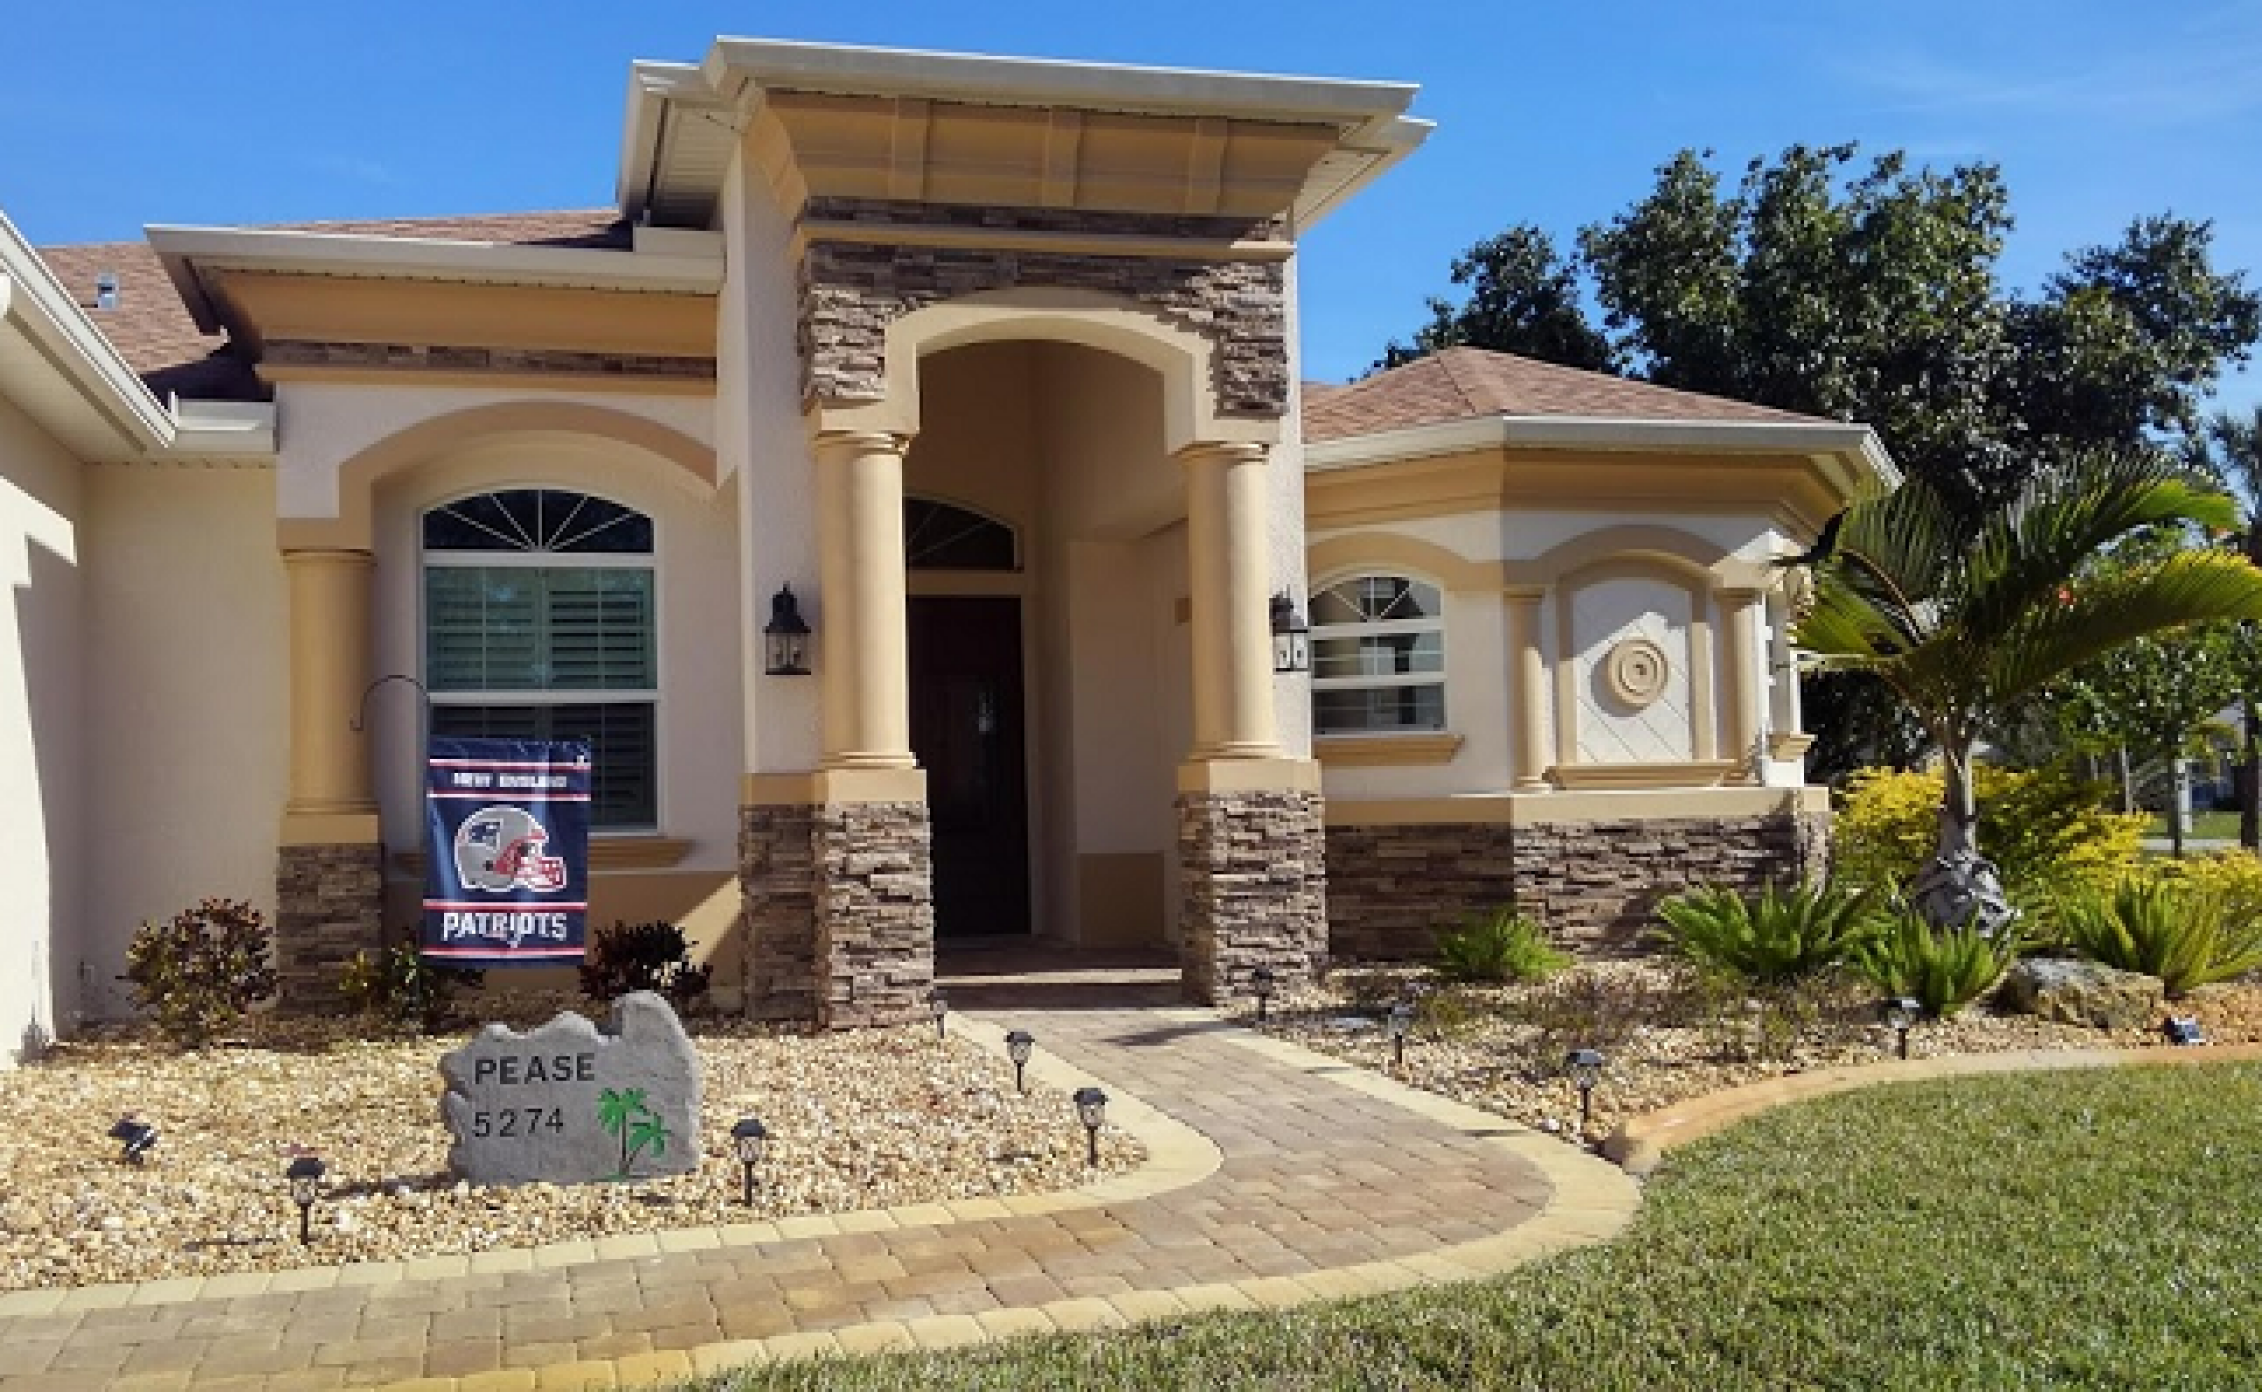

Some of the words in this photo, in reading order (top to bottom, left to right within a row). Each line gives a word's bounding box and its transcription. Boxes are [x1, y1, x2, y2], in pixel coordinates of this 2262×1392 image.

[441, 912, 568, 949] PATRIOTS
[474, 1053, 596, 1085] PEASE
[472, 1107, 565, 1138] 5274
